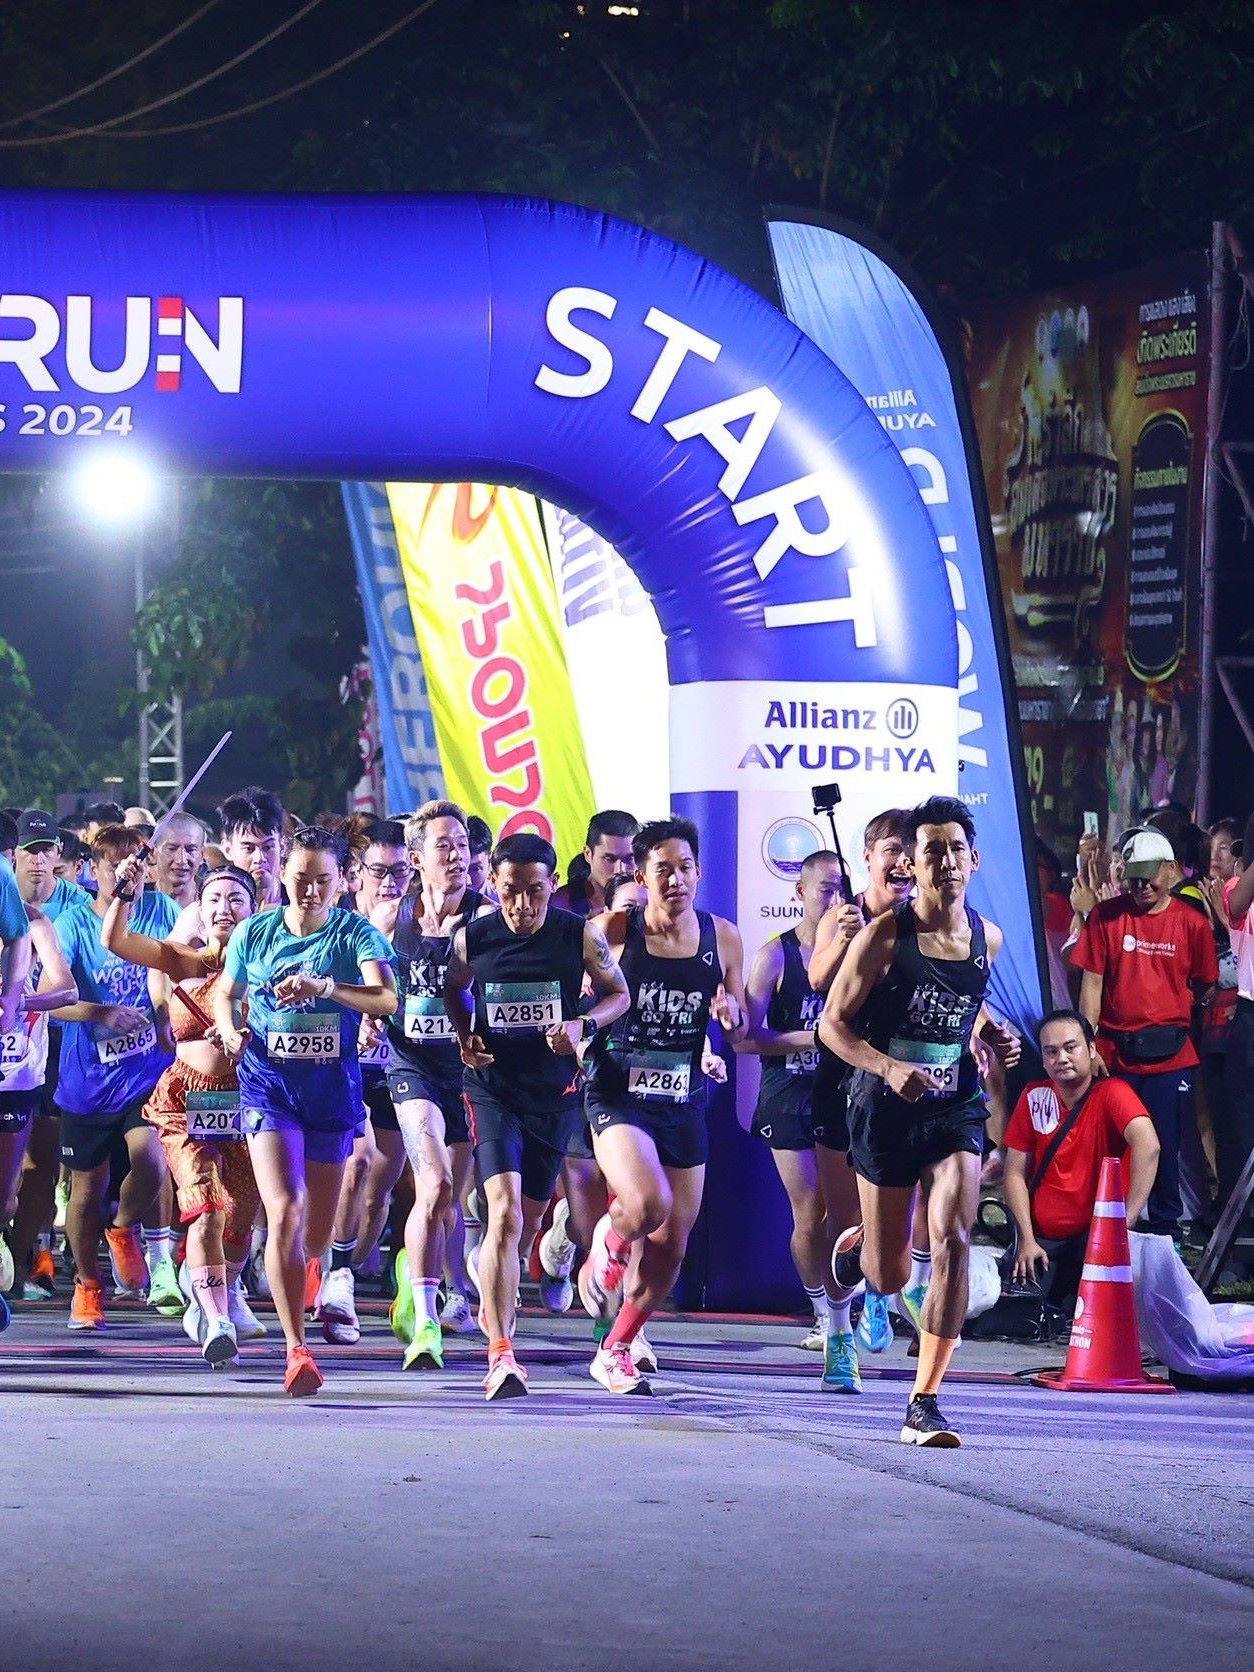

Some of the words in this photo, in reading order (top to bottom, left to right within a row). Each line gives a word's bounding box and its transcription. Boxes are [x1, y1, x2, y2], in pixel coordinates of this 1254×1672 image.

[21, 404, 135, 438] 2024
[533, 286, 877, 648] START
[764, 701, 877, 730] Allianz
[737, 744, 936, 773] AYUDHYA
[636, 983, 703, 1012] KIDS
[494, 1004, 554, 1023] A2851
[669, 1011, 692, 1025] TRI
[106, 1029, 153, 1057] A2865
[273, 1035, 334, 1053] A2958
